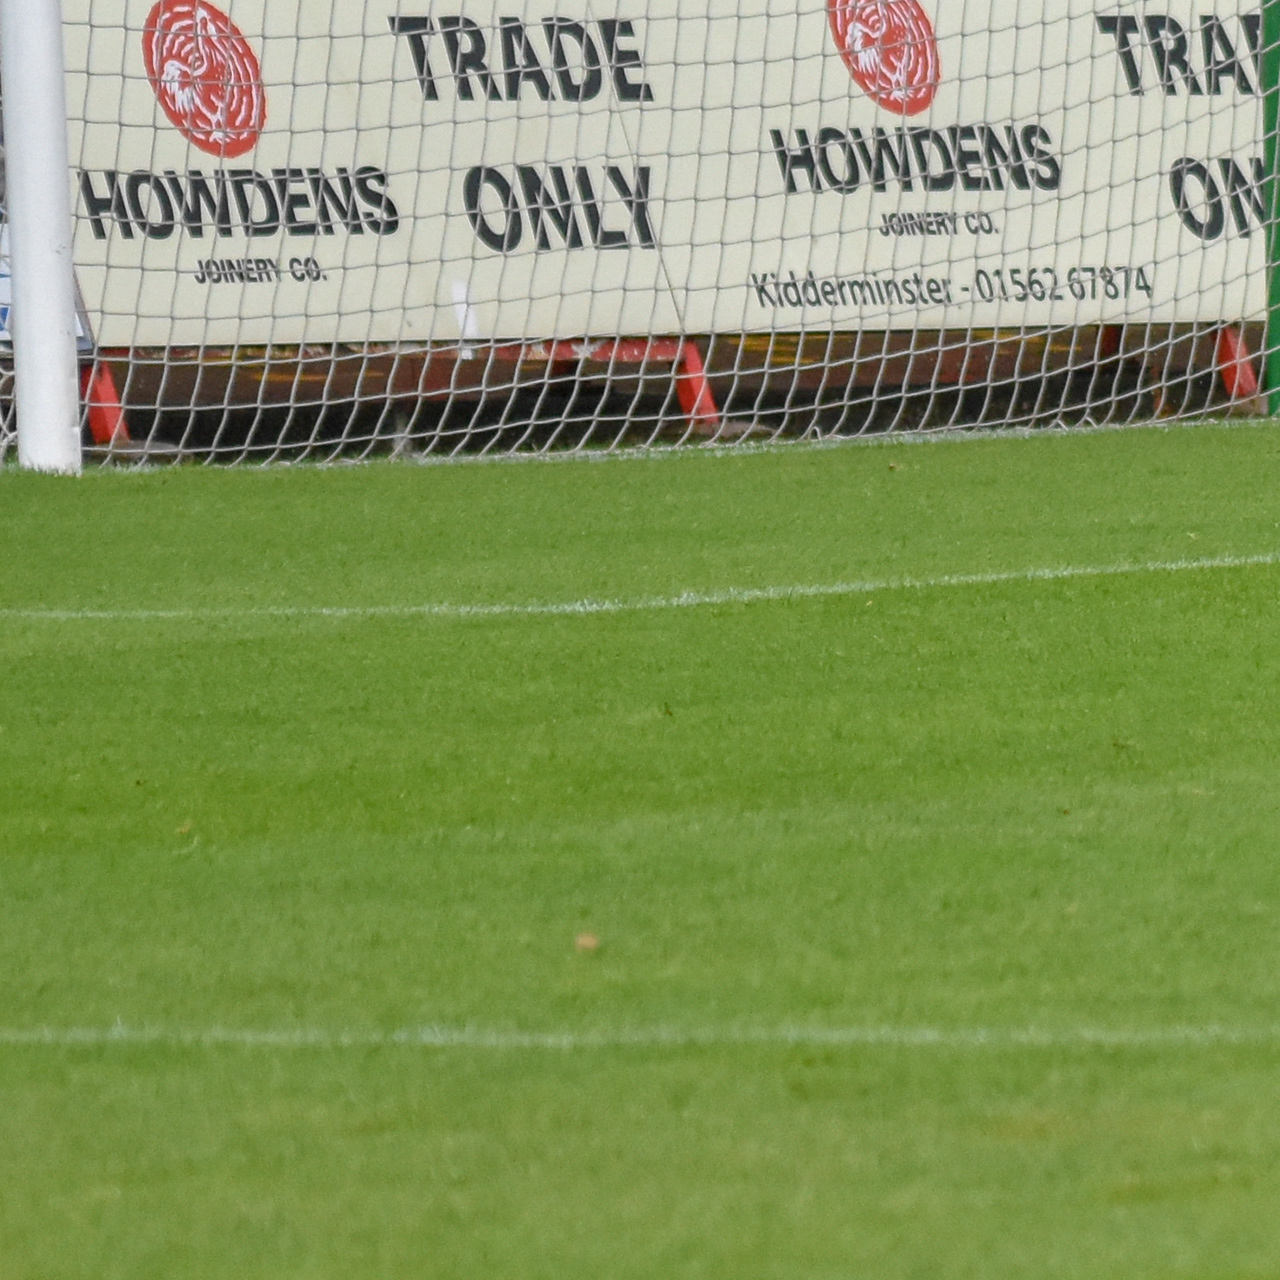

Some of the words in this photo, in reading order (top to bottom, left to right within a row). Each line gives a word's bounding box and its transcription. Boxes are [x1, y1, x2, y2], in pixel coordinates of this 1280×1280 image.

[388, 16, 654, 102] TRADE
[765, 125, 1060, 194] HOWDENS
[76, 166, 399, 240] HOWDENS
[463, 166, 655, 252] ONLY
[879, 212, 957, 237] JOINERY
[964, 211, 999, 235] CO.
[194, 259, 281, 284] JOINERY
[289, 258, 329, 282] CO.
[751, 271, 953, 307] Kidderminster
[976, 268, 1064, 303] 01562
[1070, 266, 1151, 301] 67874
